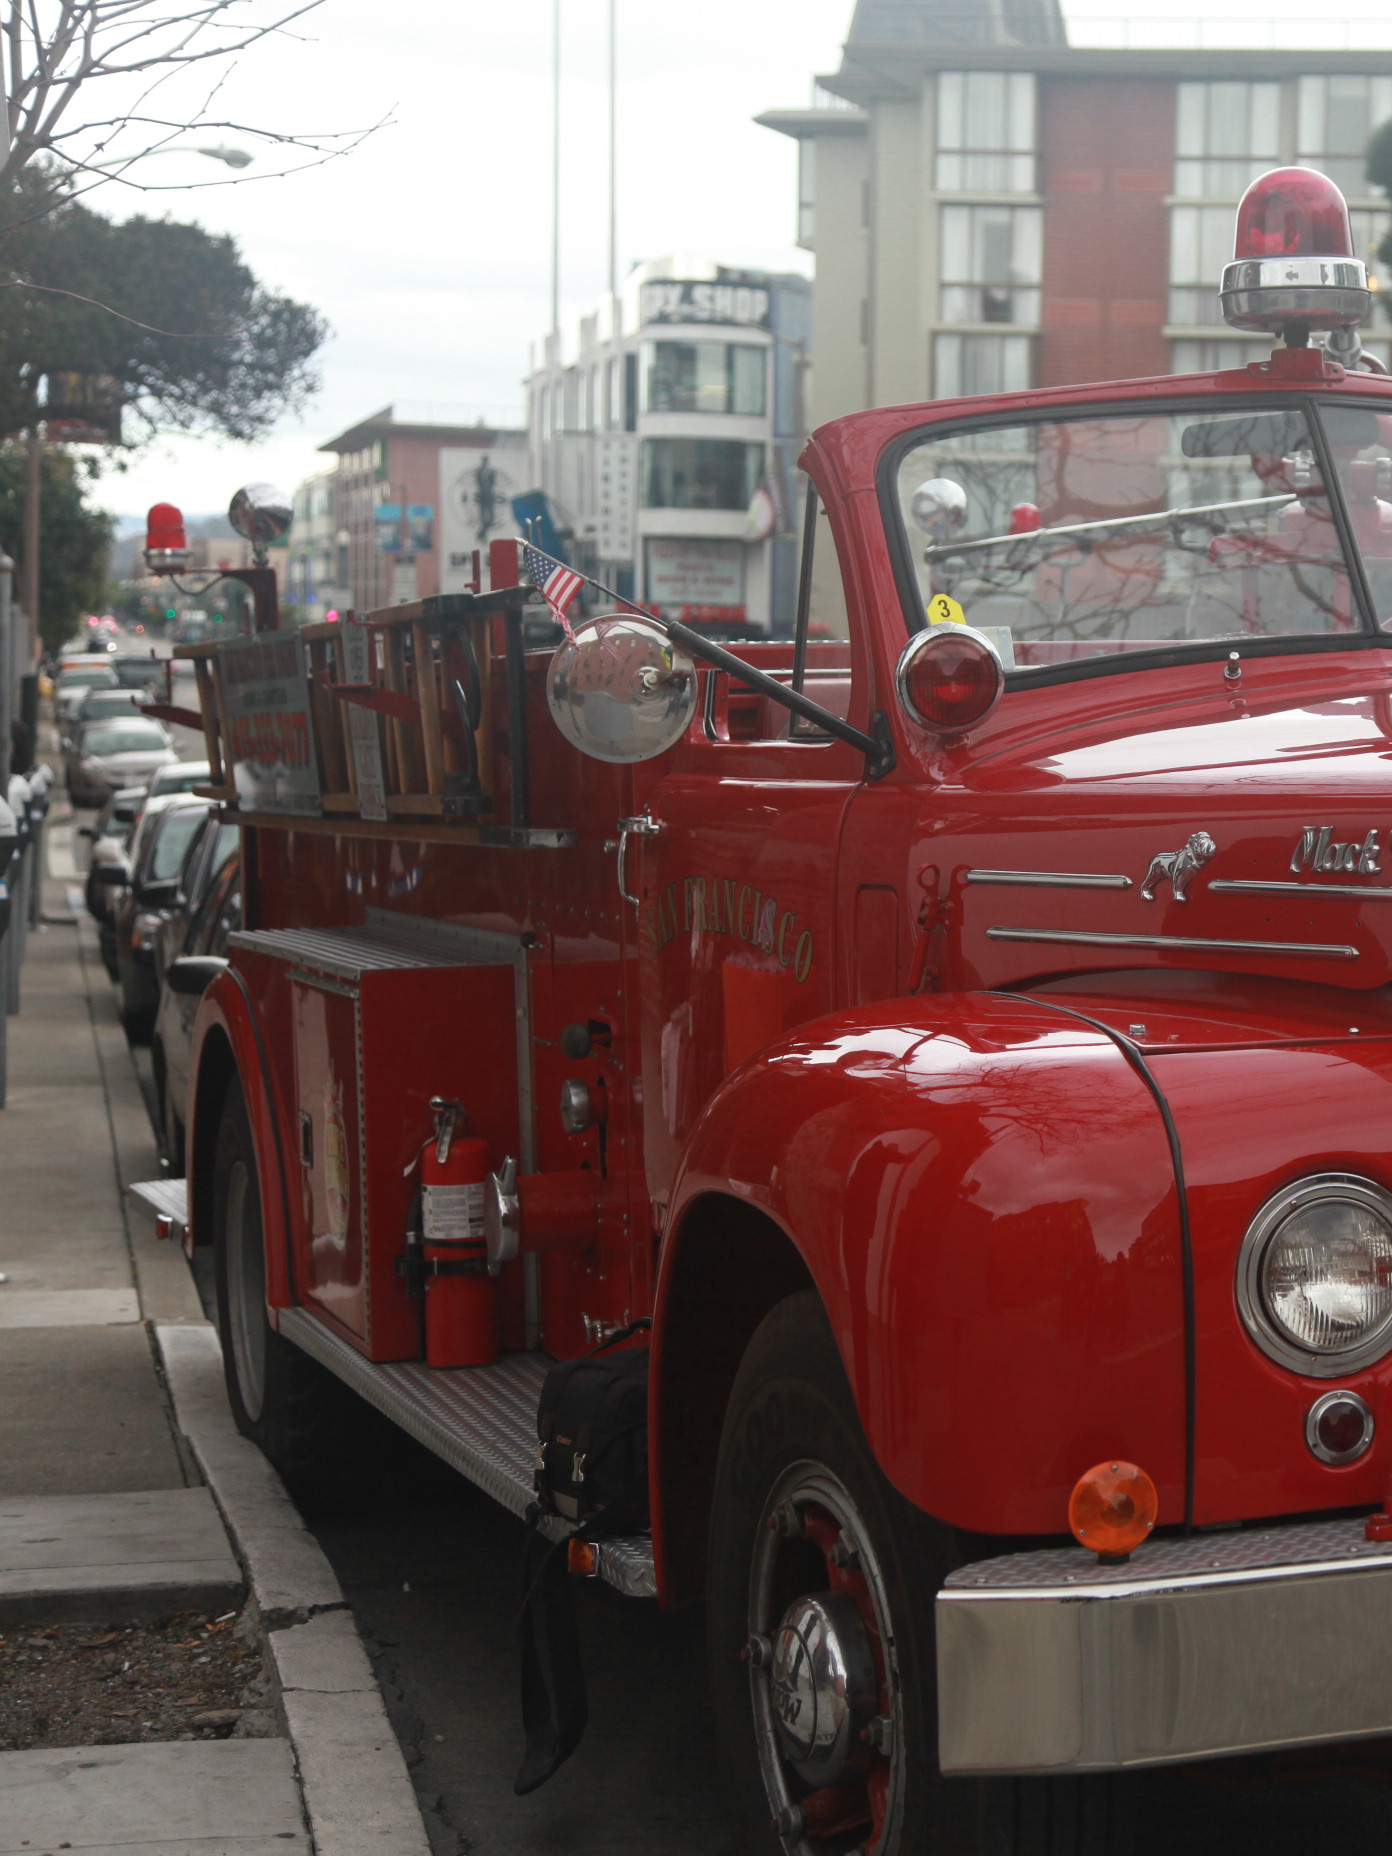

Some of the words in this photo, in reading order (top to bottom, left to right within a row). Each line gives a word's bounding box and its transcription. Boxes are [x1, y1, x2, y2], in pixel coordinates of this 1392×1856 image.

[691, 284, 769, 323] SHOP
[937, 599, 951, 618] 3
[1289, 825, 1382, 874] Mack
[683, 875, 813, 984] FRANCISCO
